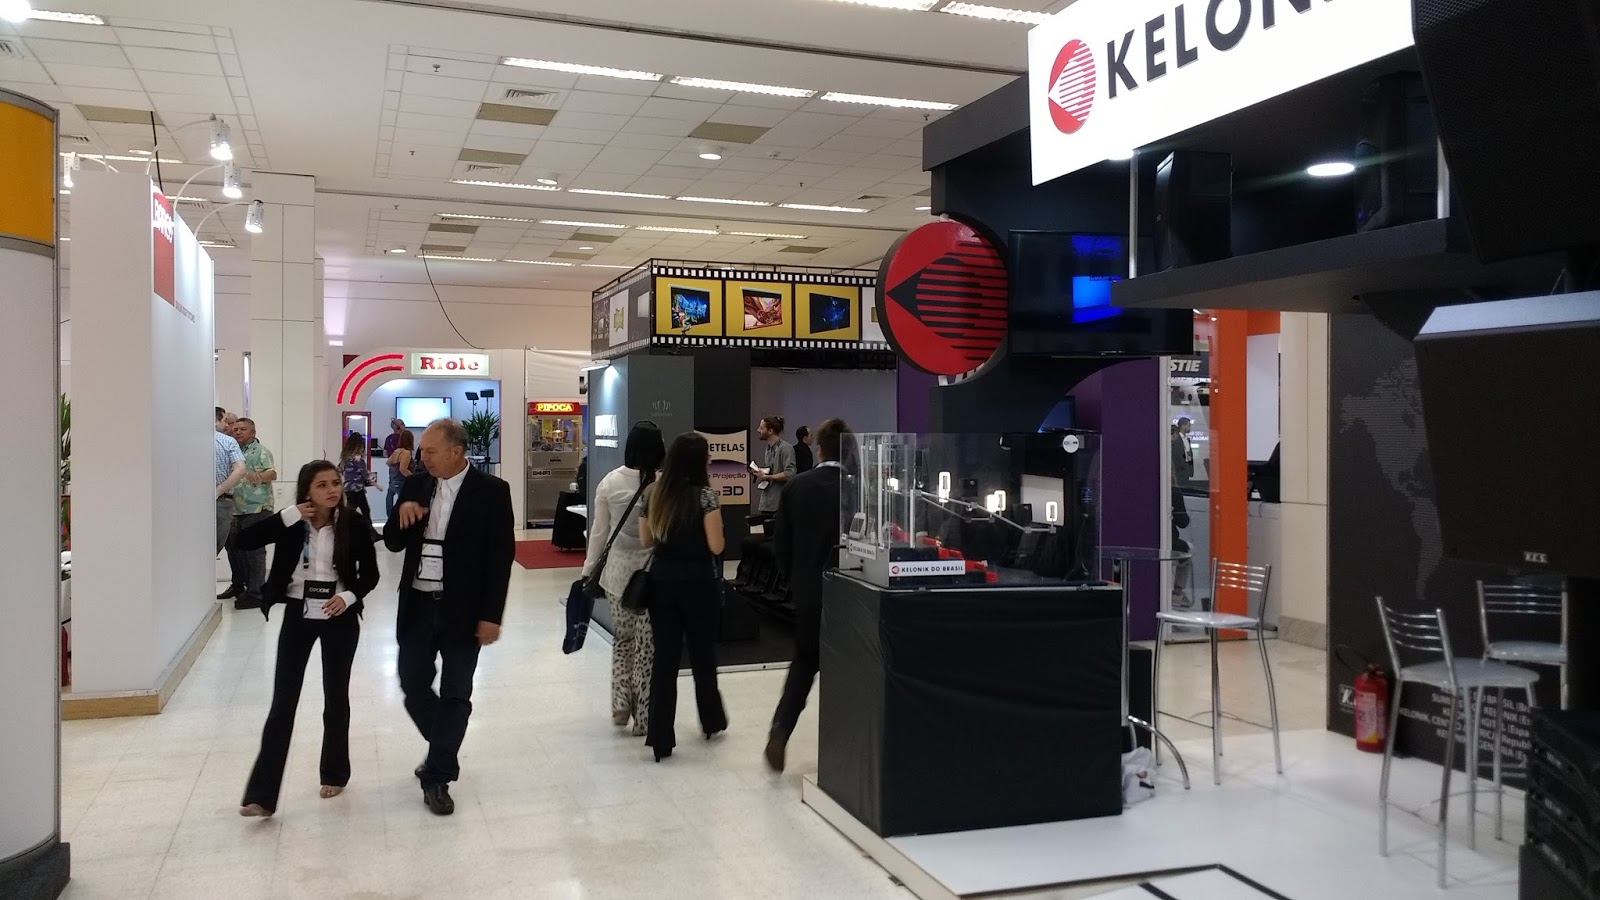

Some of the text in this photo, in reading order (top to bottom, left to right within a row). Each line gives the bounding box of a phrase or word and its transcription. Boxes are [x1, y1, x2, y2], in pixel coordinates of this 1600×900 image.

[1106, 0, 1335, 100] KELO
[420, 356, 479, 371] Riole
[536, 403, 573, 412] PIPOCA
[712, 472, 747, 480] Projeção
[722, 485, 744, 496] 3D
